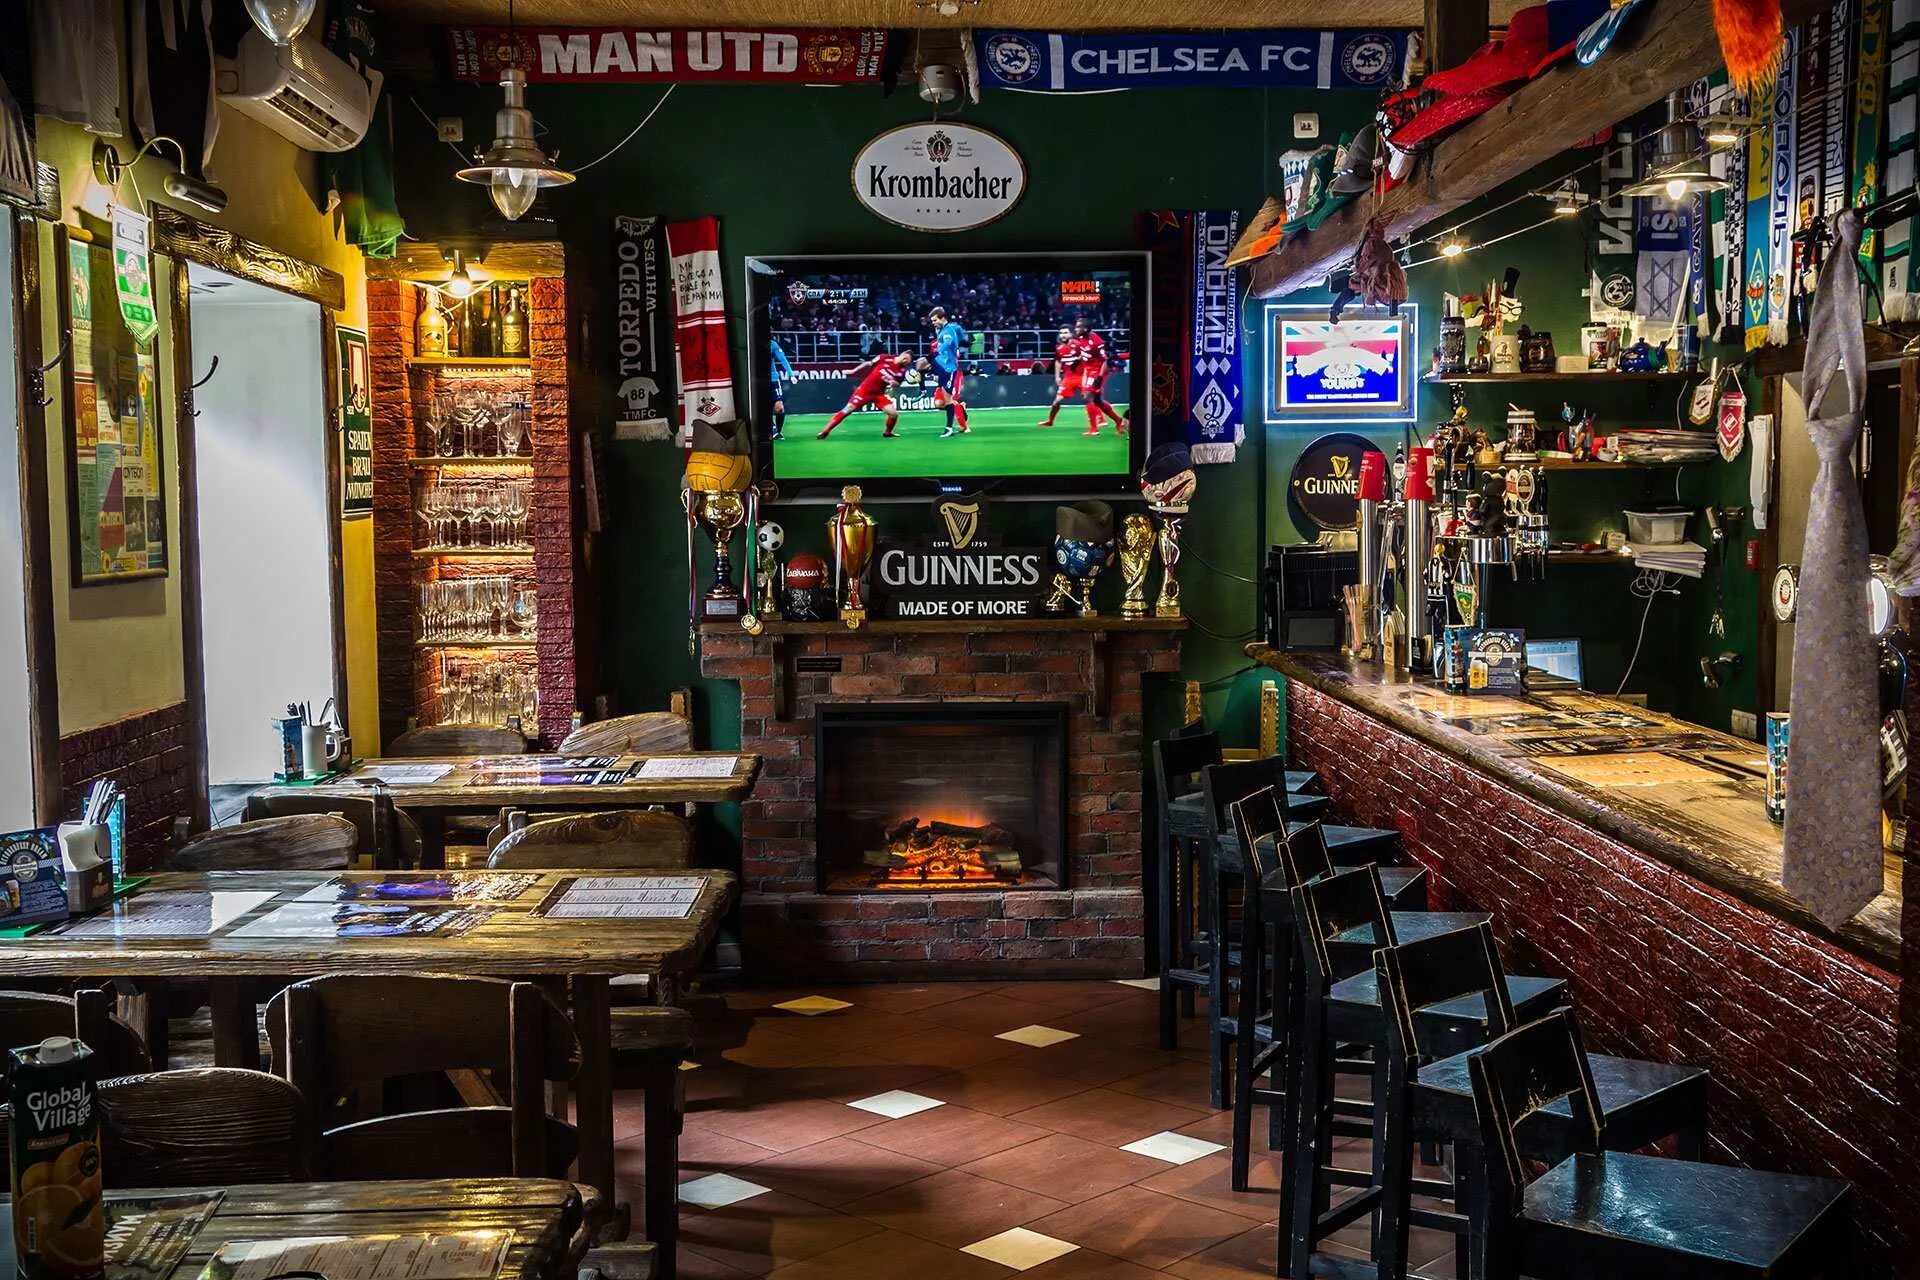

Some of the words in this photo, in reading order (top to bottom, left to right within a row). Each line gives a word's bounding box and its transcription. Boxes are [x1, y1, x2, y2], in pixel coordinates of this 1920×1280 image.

[538, 32, 677, 74] MAN
[686, 31, 799, 72] UTD
[1071, 46, 1250, 74] CHELSEA
[1261, 44, 1312, 71] FC
[869, 164, 1013, 200] Krombacher
[643, 238, 657, 313] WHITES
[1203, 224, 1230, 354] ДИНАМО
[617, 241, 642, 377] TORPEDO
[630, 388, 645, 400] 88
[623, 408, 657, 421] TMFC
[1304, 476, 1359, 495] GUINNE
[880, 549, 1040, 586] GUINNESS
[898, 601, 948, 616] MADE
[951, 600, 975, 615] OF
[977, 600, 1029, 615] MORE
[26, 1081, 86, 1111] Global
